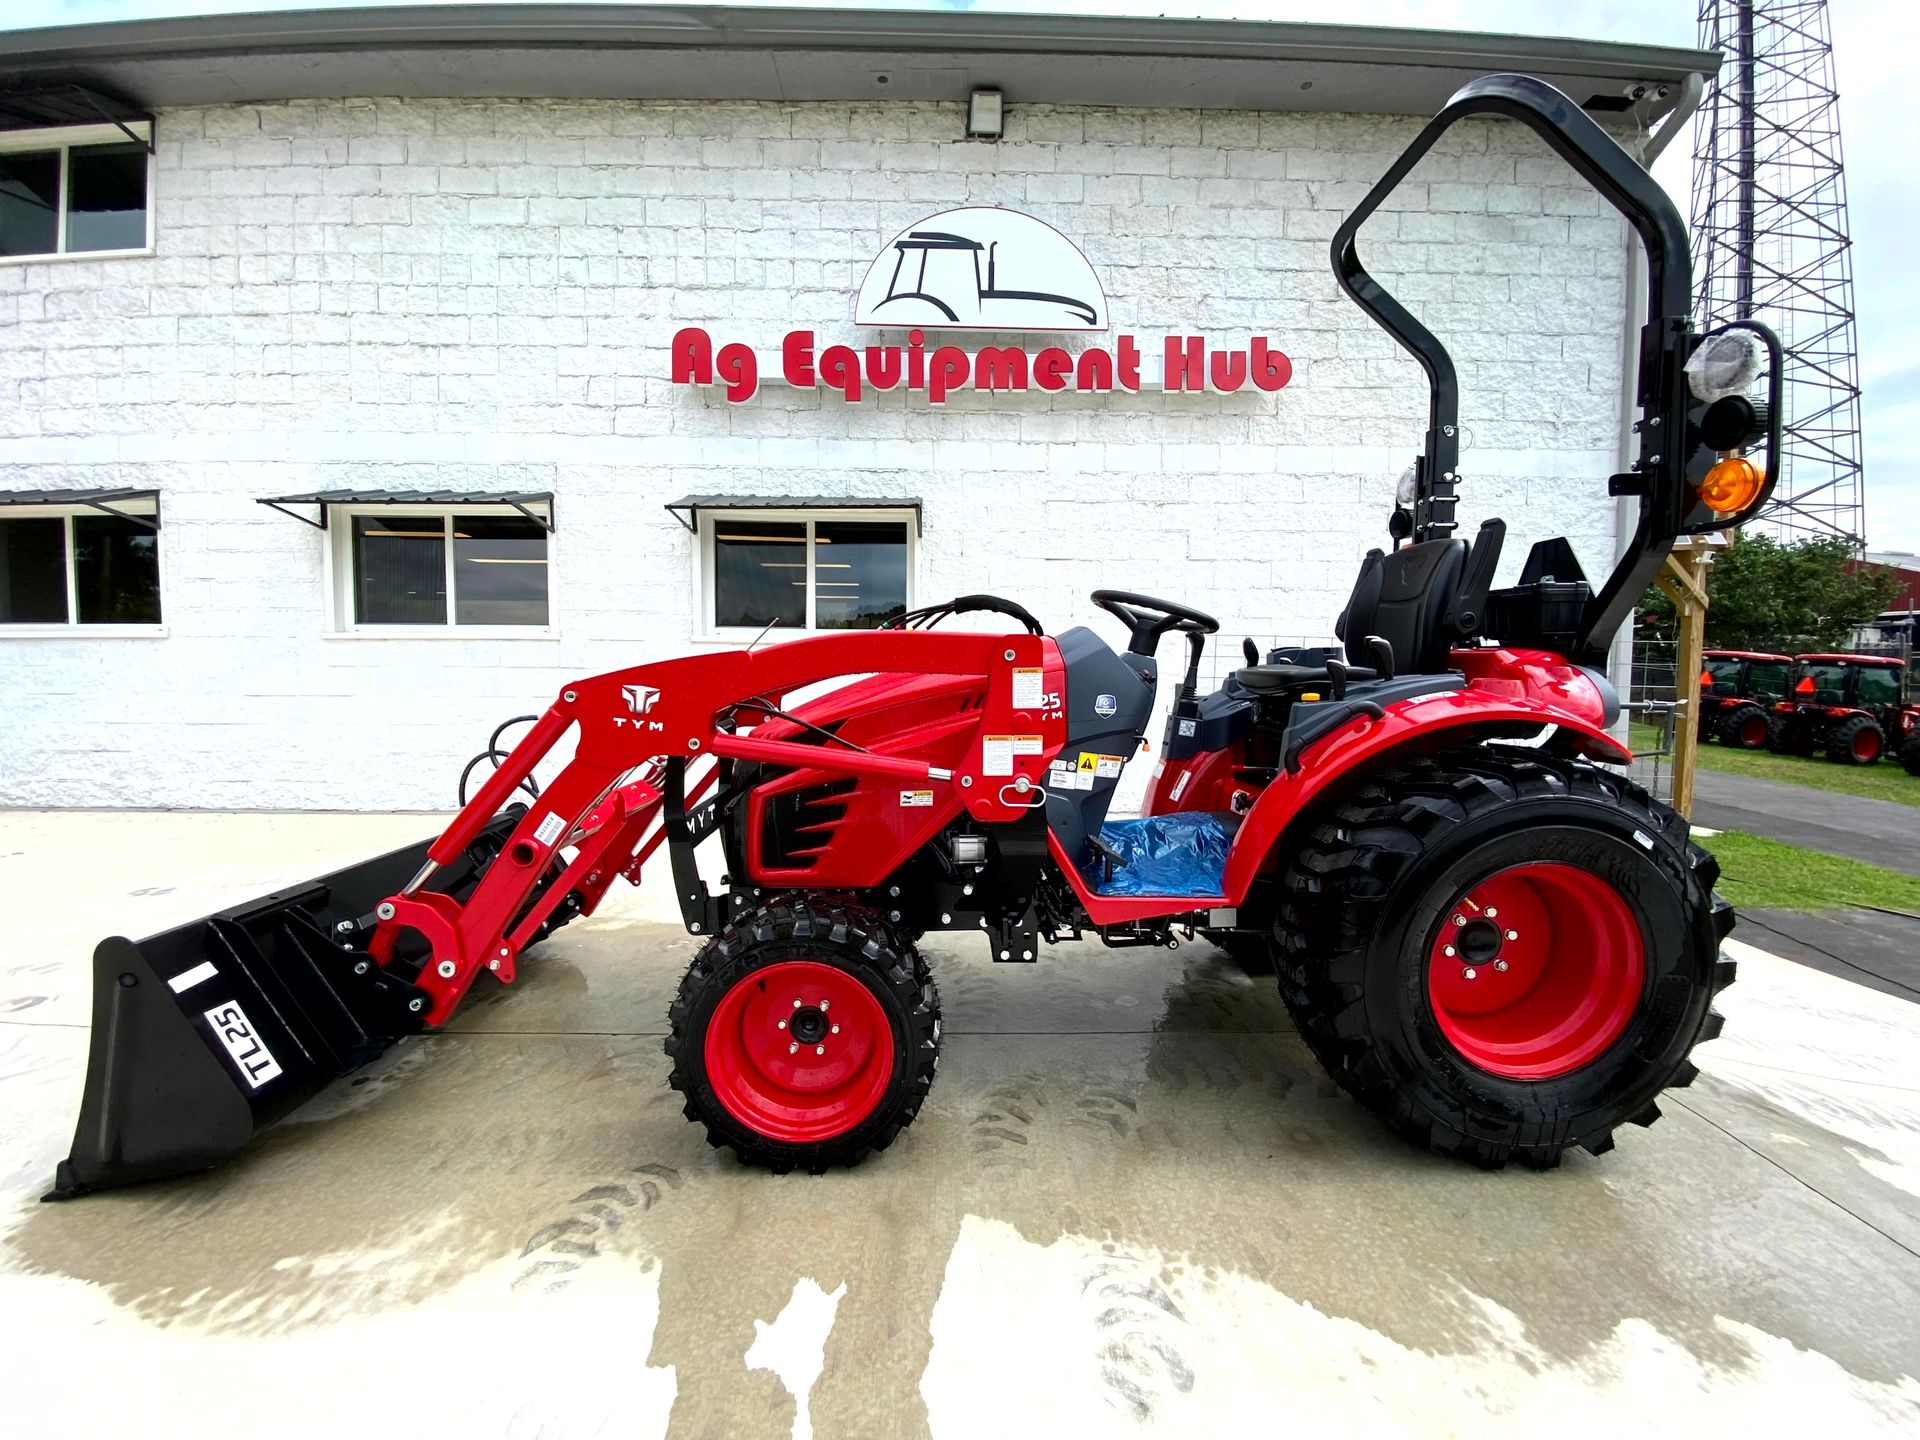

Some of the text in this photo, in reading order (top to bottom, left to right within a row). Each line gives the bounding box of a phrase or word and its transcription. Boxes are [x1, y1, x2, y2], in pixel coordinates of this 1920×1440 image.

[672, 328, 1292, 402] Ag Equipment Hub
[613, 718, 664, 732] TYM
[213, 1007, 271, 1081] TL25
